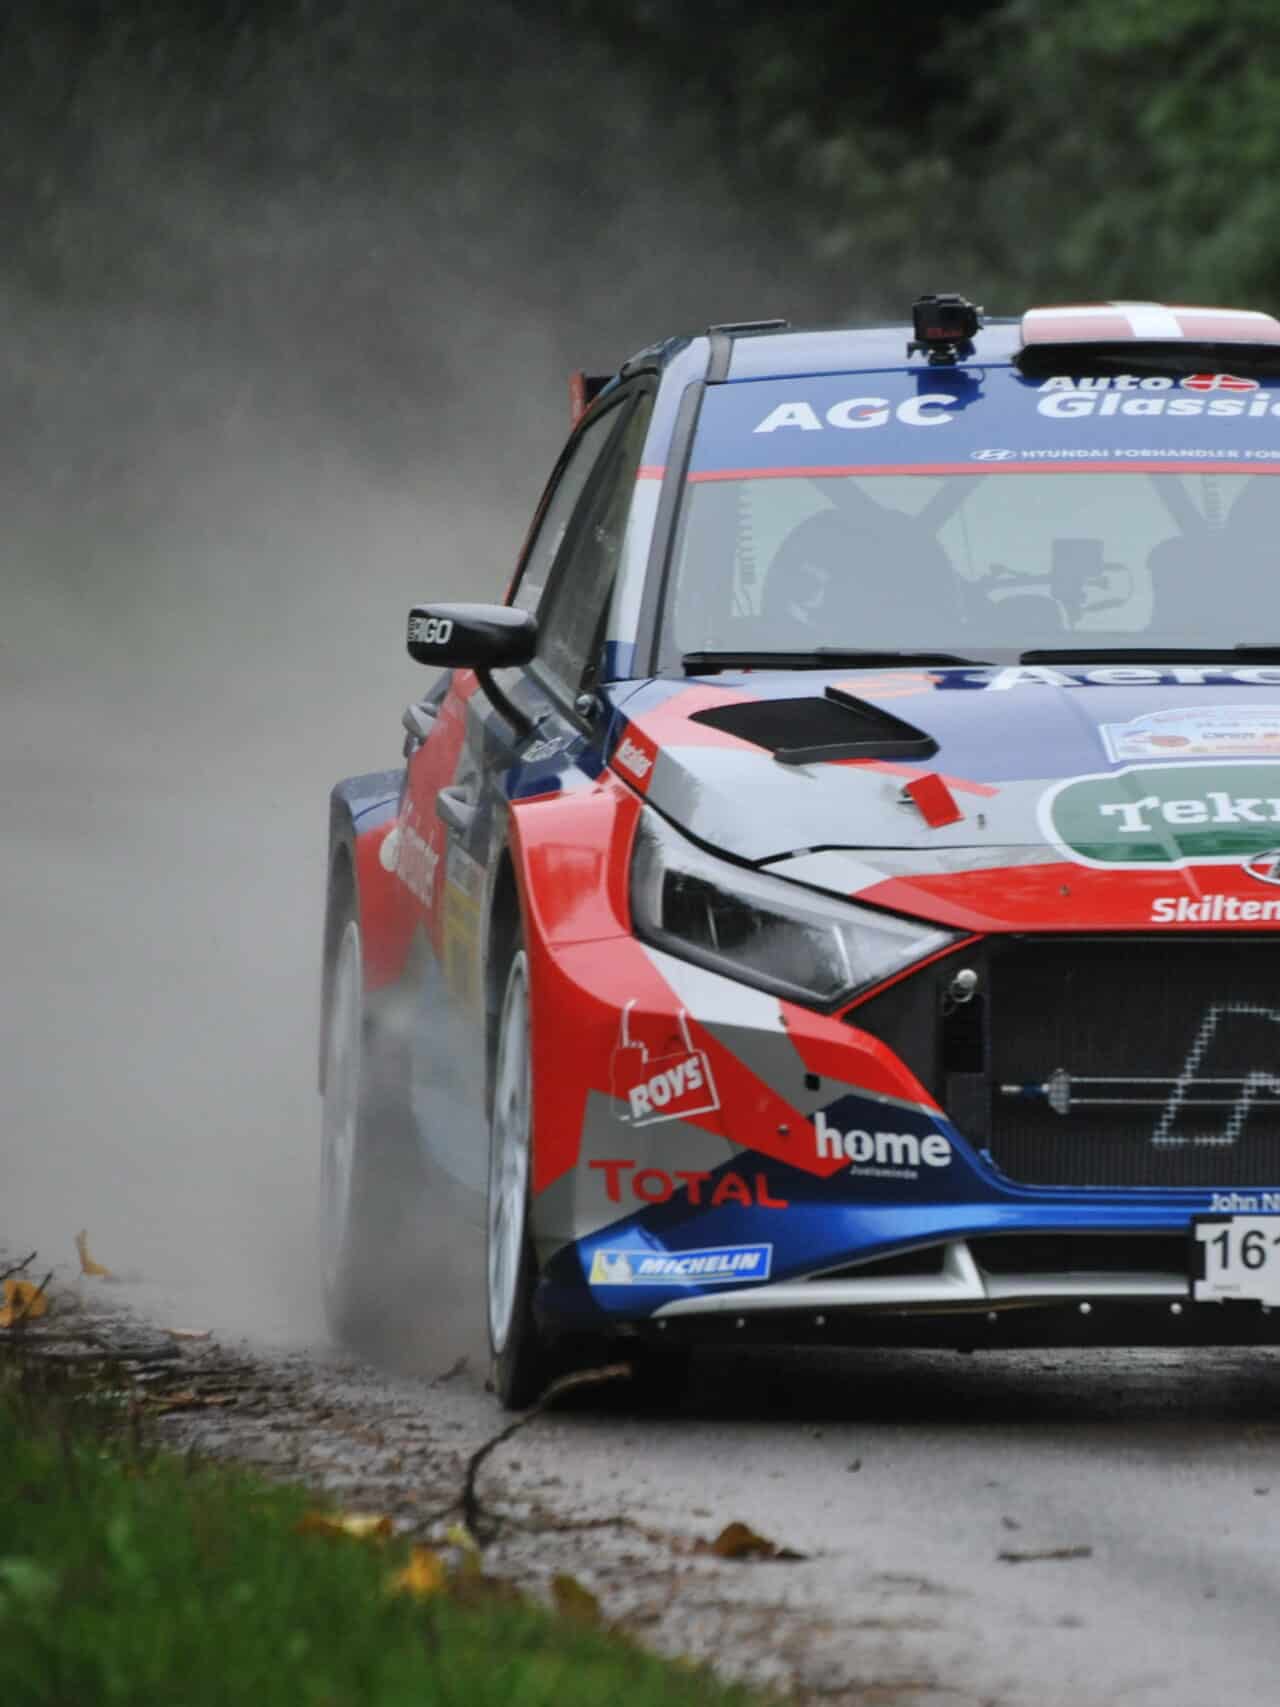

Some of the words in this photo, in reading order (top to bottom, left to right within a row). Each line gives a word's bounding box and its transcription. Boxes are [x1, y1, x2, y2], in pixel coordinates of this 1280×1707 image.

[1037, 375, 1175, 392] Auto
[753, 393, 958, 432] AGC
[1022, 449, 1109, 459] HYUNDAI
[628, 1056, 704, 1119] ROYS
[814, 1111, 952, 1168] home
[589, 1159, 789, 1209] TOTAL
[1210, 1193, 1258, 1211] John
[638, 1252, 761, 1274] MICHELIN
